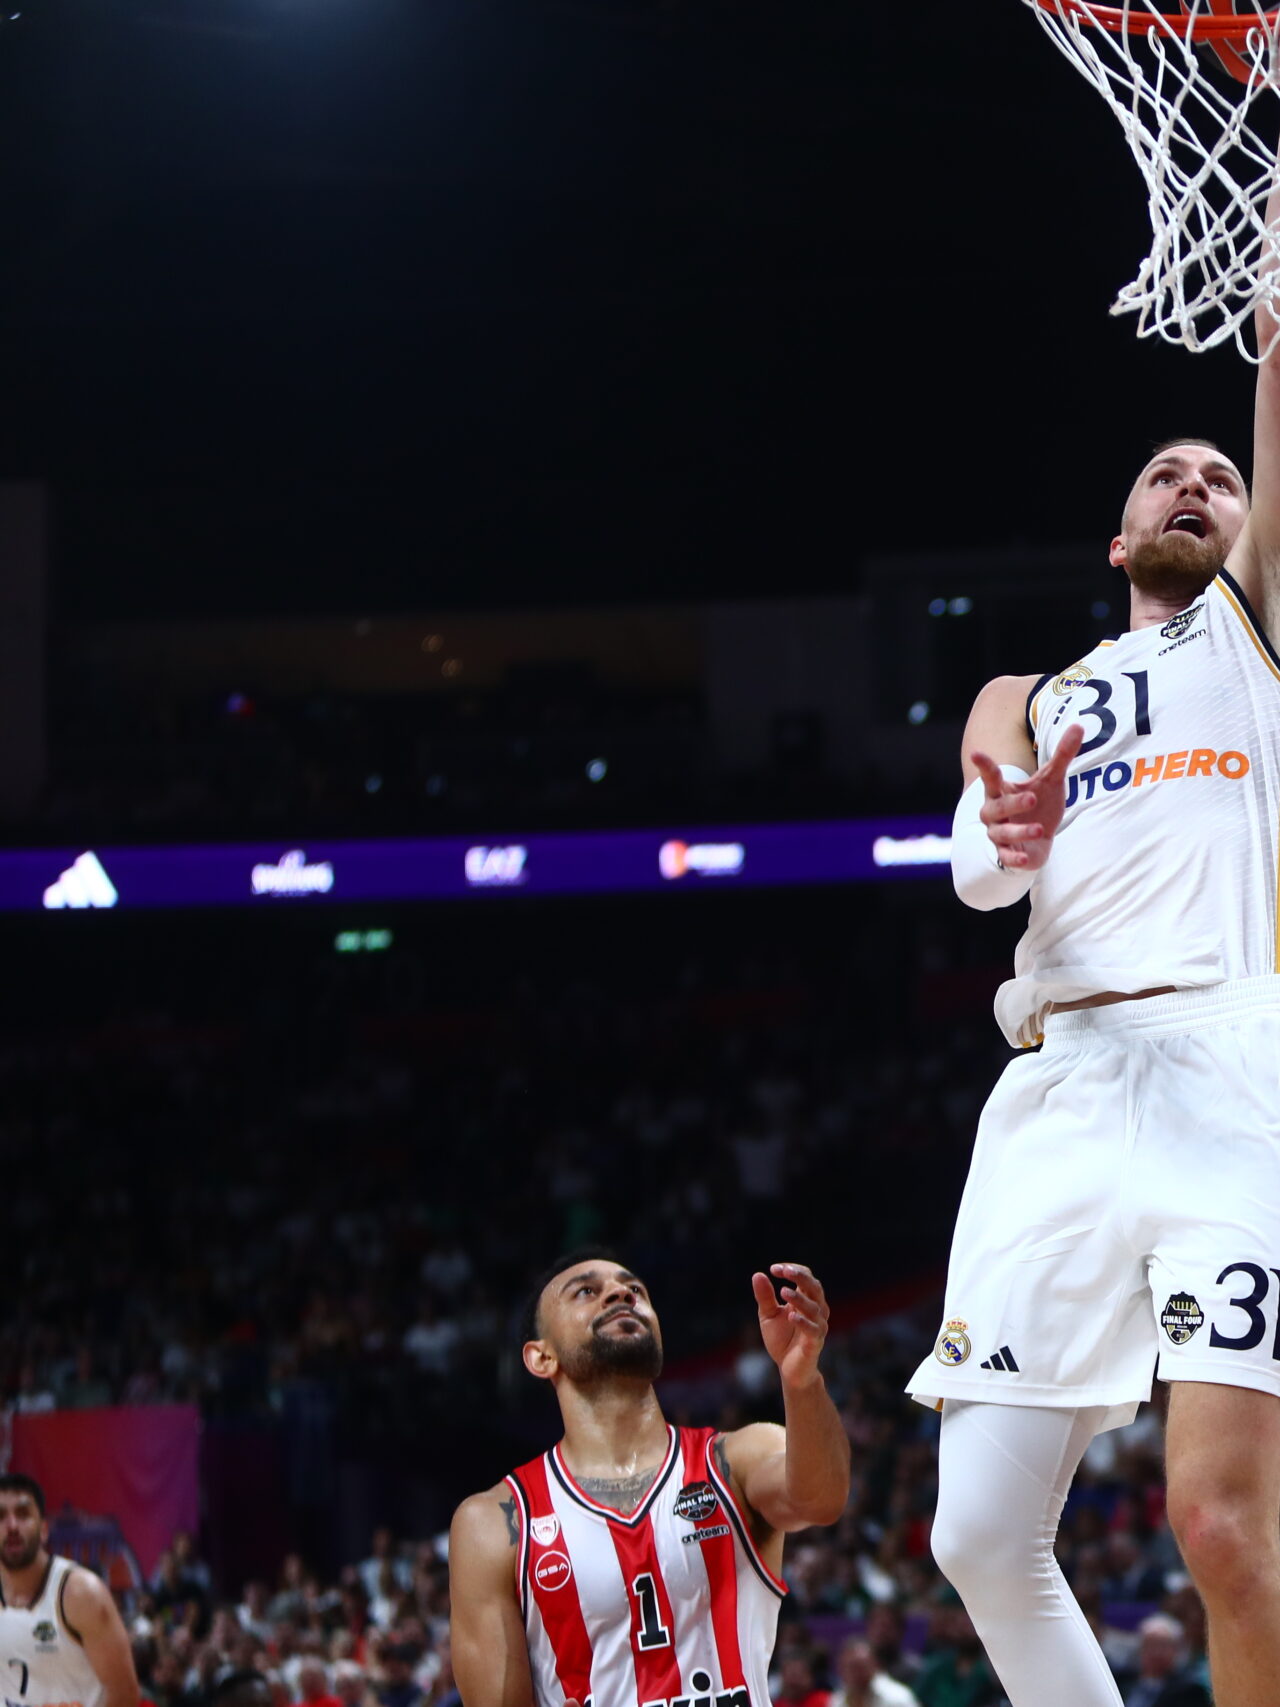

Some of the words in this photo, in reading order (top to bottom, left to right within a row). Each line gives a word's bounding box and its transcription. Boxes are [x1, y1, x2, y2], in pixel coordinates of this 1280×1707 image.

[1074, 670, 1151, 759] 31
[1065, 748, 1250, 809] UTOHERO
[1162, 1315, 1183, 1325] FINAL
[1183, 1315, 1203, 1325] FOUR
[674, 1498, 698, 1513] FINAL
[697, 1493, 717, 1504] FOU
[632, 1572, 671, 1651] 1
